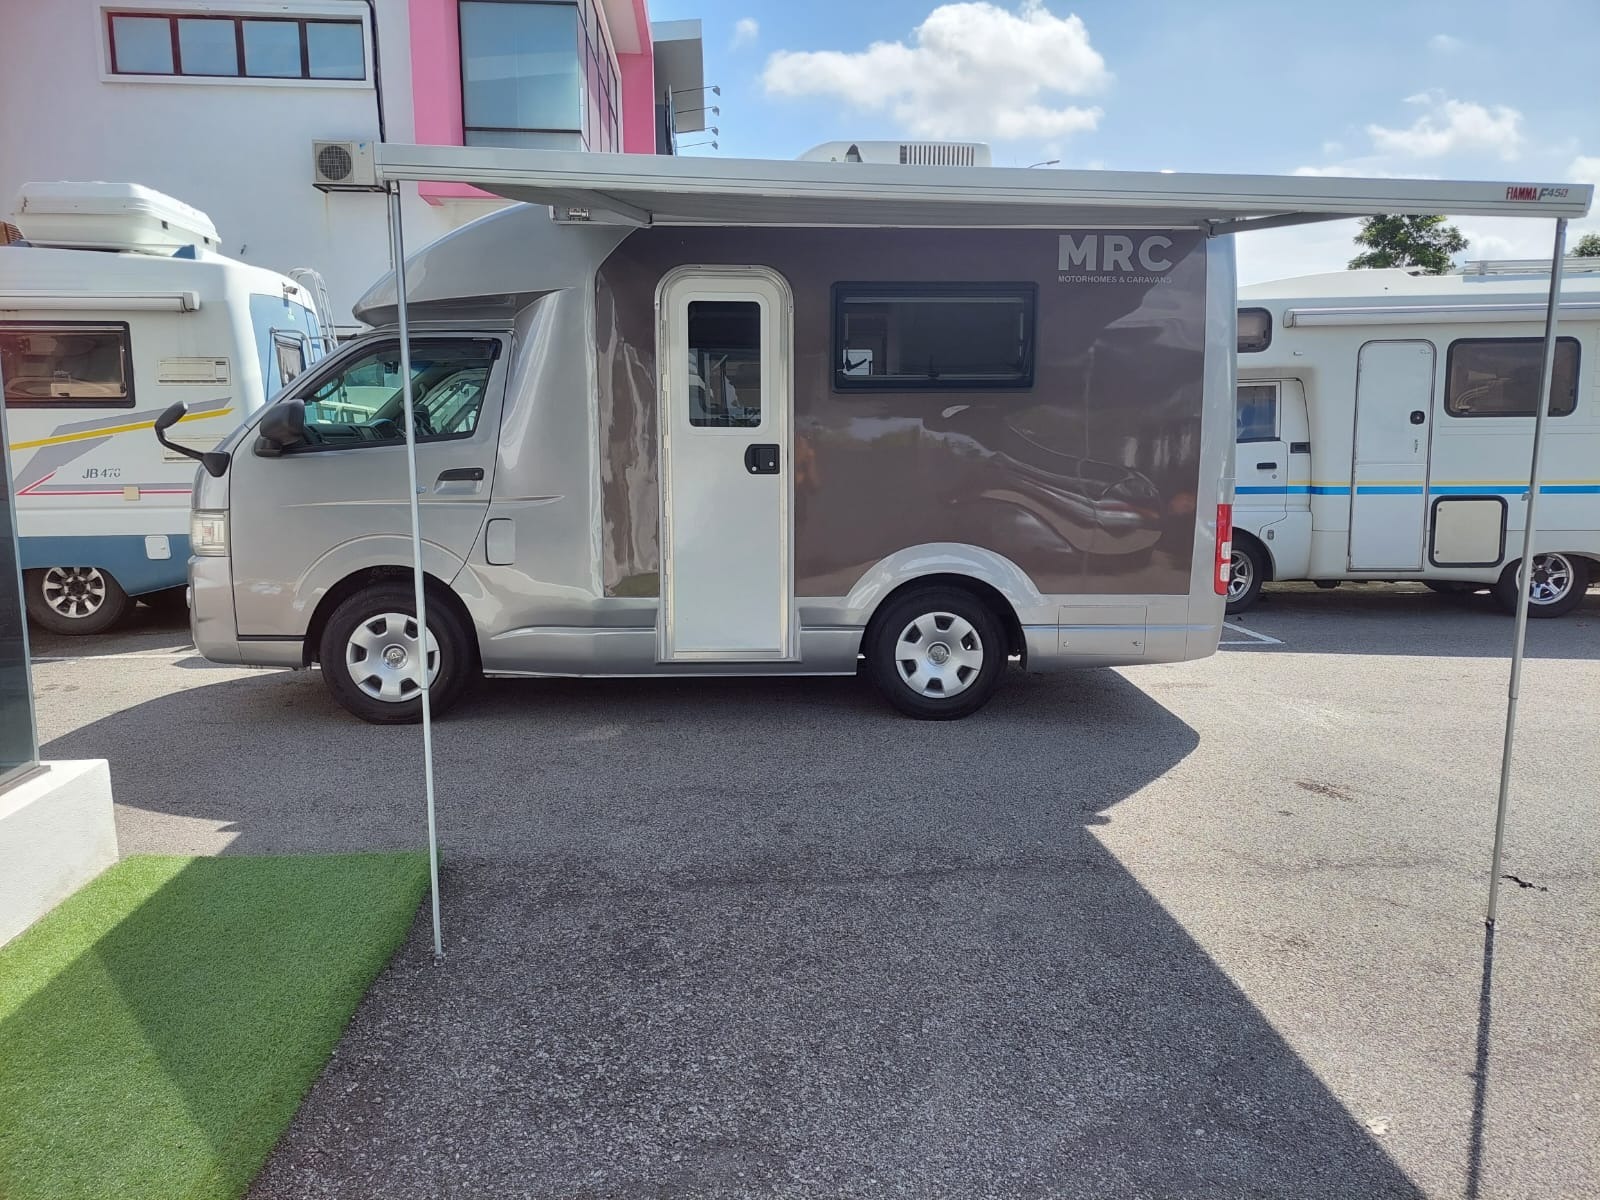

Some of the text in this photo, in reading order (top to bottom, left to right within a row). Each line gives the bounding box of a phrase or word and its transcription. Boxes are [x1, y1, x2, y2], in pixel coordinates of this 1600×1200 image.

[1506, 187, 1537, 200] FIAMMA
[1058, 234, 1173, 271] MRC
[1058, 275, 1117, 283] MOTORHOMES
[1127, 276, 1172, 284] CARAVANS
[82, 468, 98, 479] JB
